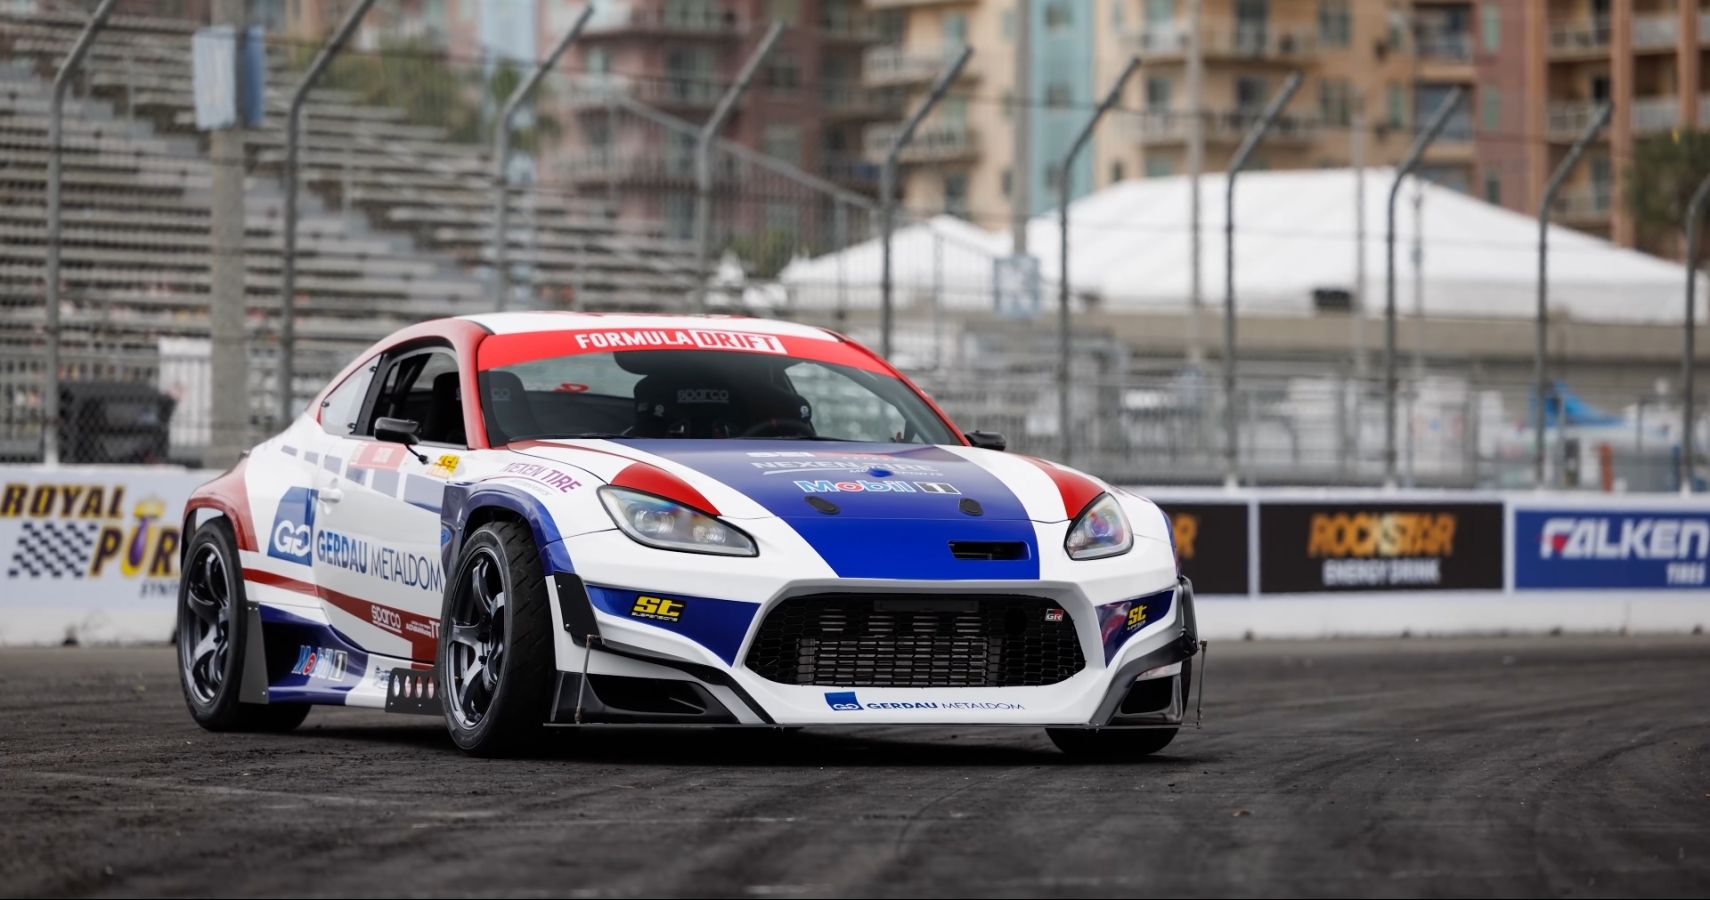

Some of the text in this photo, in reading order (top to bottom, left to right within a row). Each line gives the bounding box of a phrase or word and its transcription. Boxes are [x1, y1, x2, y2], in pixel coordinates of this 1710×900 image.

[575, 331, 784, 352] FORMULA DRIFT
[750, 461, 859, 469] NEXEN
[540, 469, 582, 493] TIRE
[794, 480, 917, 493] Mobil
[0, 484, 125, 519] ROYAL
[1308, 512, 1456, 557] ROCKSTAR
[1539, 517, 1710, 560] FALKEN
[89, 525, 180, 578] PUR
[317, 530, 444, 593] GERDAU METALDOM
[1323, 558, 1441, 585] ENERGY DRINK
[371, 604, 402, 630] sparco
[291, 645, 334, 679] Mobil
[867, 702, 1025, 710] GERDAU METALDOM
